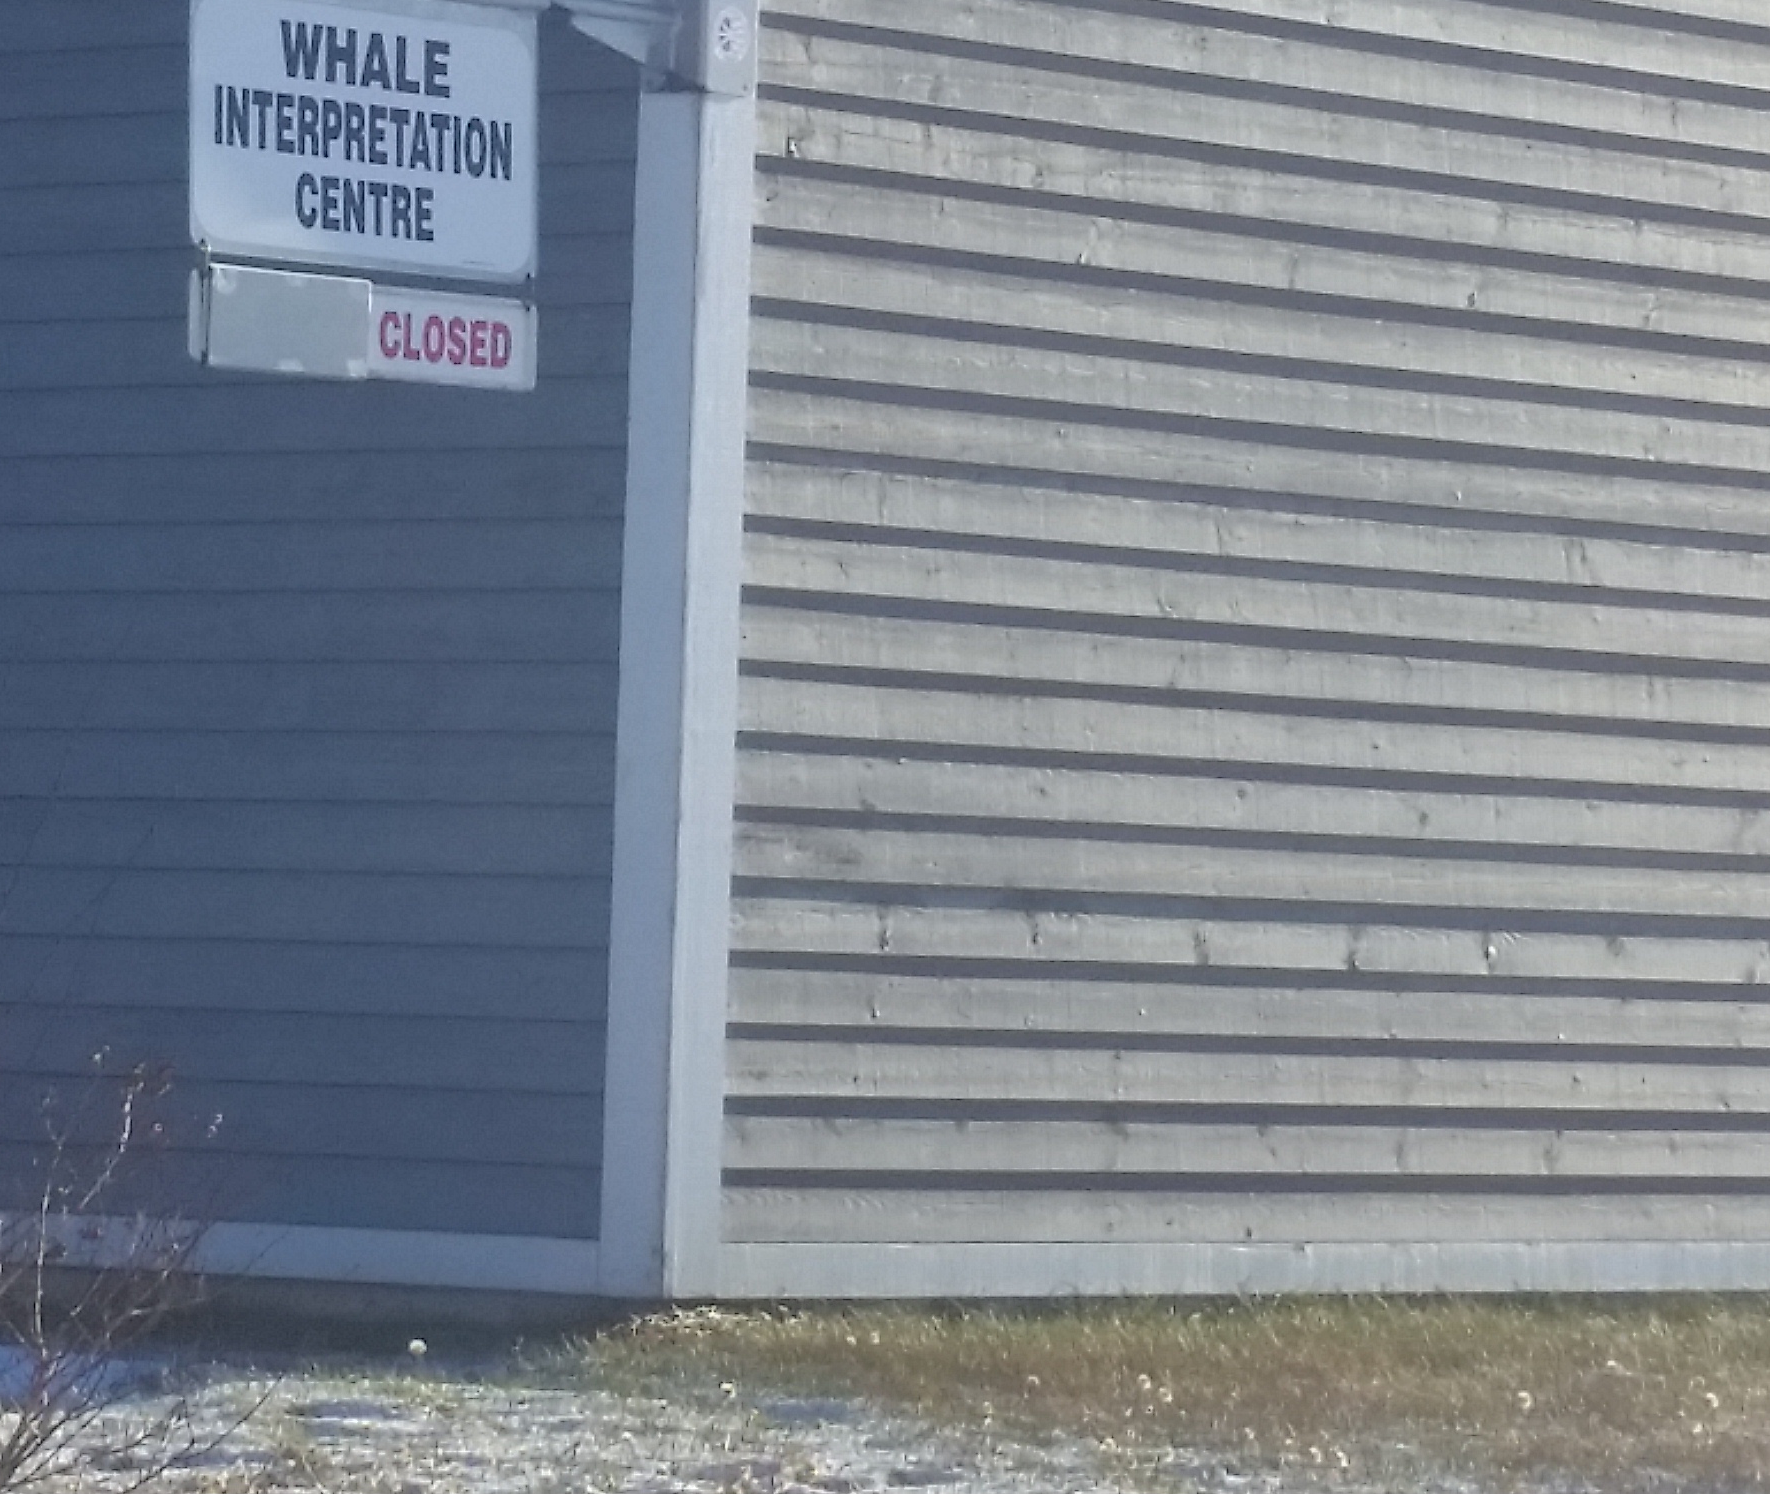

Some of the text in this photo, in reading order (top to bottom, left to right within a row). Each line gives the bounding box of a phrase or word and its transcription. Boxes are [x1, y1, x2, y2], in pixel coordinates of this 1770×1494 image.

[280, 20, 451, 98] WHALE
[214, 84, 513, 180] INTERPRETATION
[295, 173, 435, 241] CENTRE
[379, 312, 512, 369] CLOSED
